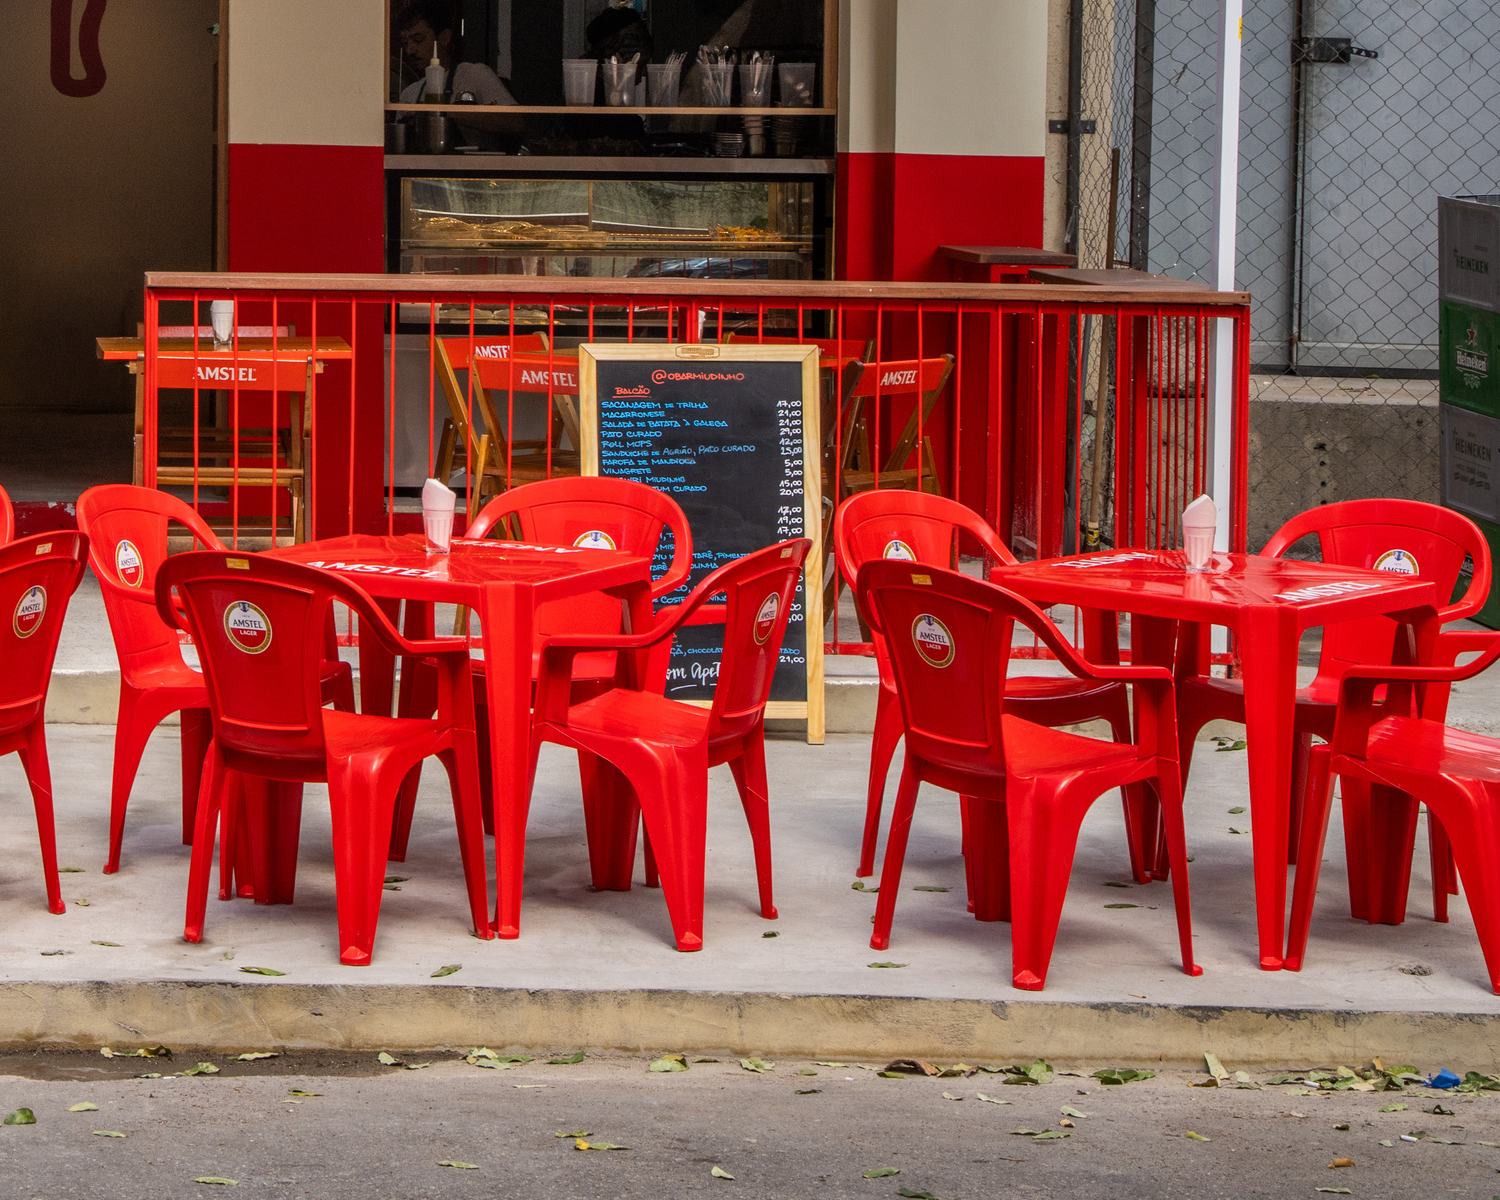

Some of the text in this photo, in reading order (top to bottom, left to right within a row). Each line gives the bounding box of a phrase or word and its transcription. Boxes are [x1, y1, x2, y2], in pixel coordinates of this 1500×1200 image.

[1456, 350, 1488, 372] Heineken
[191, 366, 257, 381] AMSTEL
[521, 370, 577, 387] AMSTEL
[651, 369, 745, 384] @OBARMIUDINHO
[879, 370, 918, 386] AMSTEL
[614, 385, 651, 395] BALCÃO
[601, 401, 661, 409] SACANAGEM
[676, 401, 709, 409] TRILHA
[601, 420, 635, 428] SALADA
[648, 420, 681, 428] BATATA
[693, 419, 729, 427] GALEGA
[600, 430, 623, 438] PATO
[626, 430, 663, 438] CURADO
[626, 440, 652, 448] MOPS
[721, 445, 756, 453] CURADO
[601, 458, 636, 466] FAROFA
[651, 458, 697, 466] MANDIOCA
[784, 459, 803, 467] 5,00
[602, 467, 803, 477] VINAGRETE 5,00
[120, 557, 139, 568] AMSTEL
[306, 561, 442, 578] AMSTEL
[20, 602, 42, 613] AMSTEL
[232, 619, 264, 629] AMSTEL
[239, 629, 258, 637] LAGER
[919, 631, 947, 644] AMSTEL
